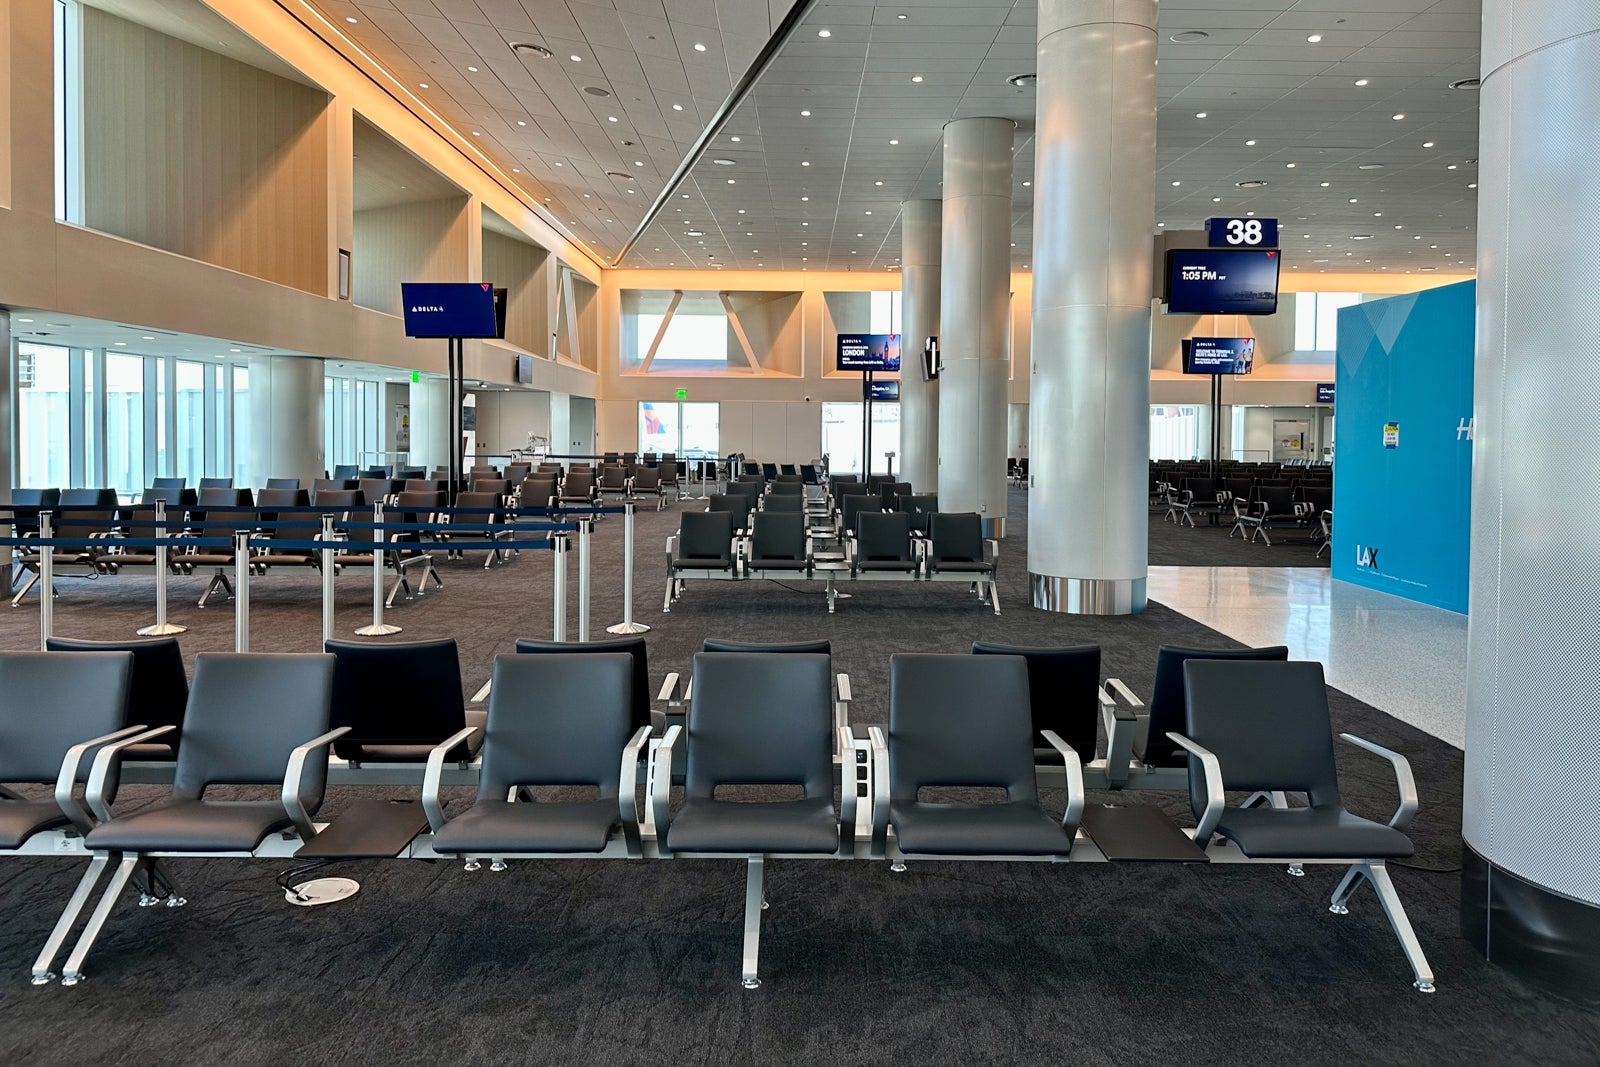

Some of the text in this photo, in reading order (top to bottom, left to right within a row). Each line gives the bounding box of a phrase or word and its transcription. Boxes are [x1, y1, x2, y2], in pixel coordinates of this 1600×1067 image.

[1226, 219, 1262, 245] 38
[1182, 271, 1200, 280] 1:05
[1202, 271, 1216, 280] PM
[1456, 417, 1473, 441] H
[1356, 544, 1379, 569] LAX
